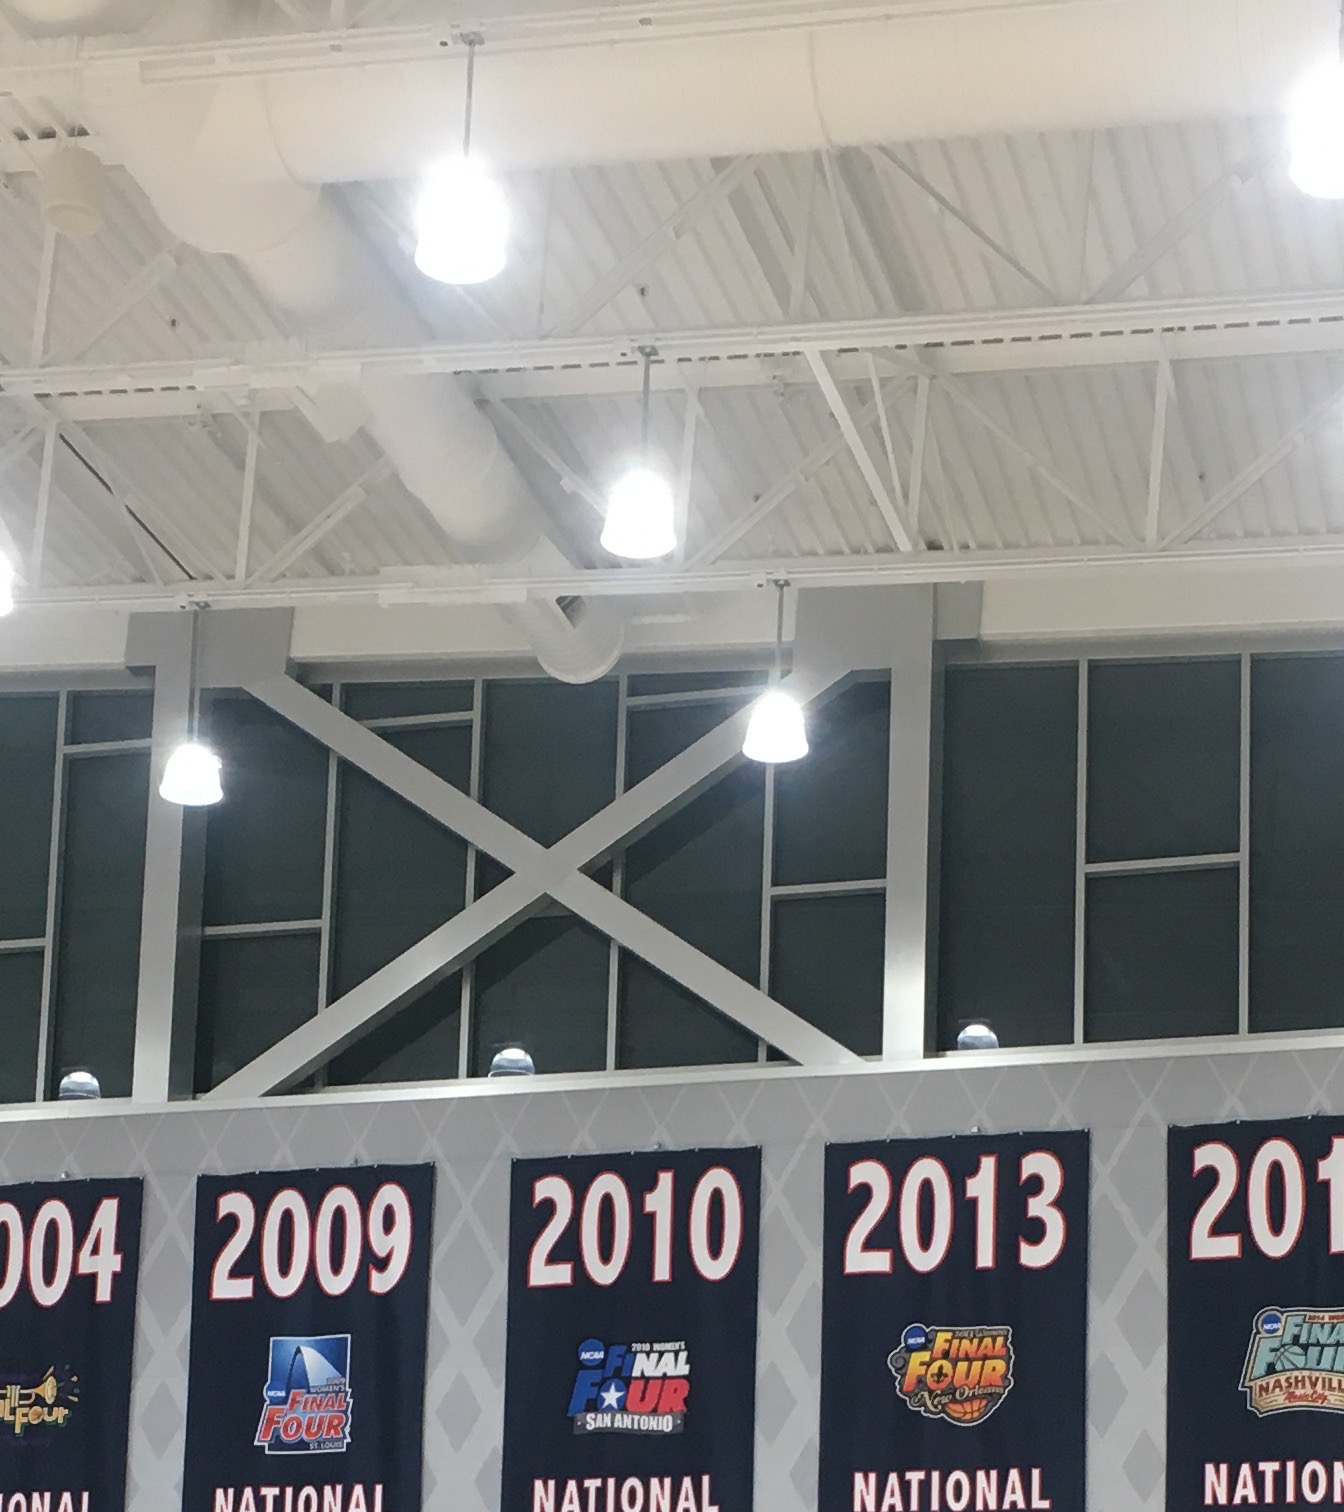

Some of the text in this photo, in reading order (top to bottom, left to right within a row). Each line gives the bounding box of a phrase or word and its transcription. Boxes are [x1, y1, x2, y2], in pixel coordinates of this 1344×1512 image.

[527, 1166, 743, 1288] 2010
[843, 1149, 1067, 1275] 2013
[209, 1182, 413, 1301] 2009
[579, 1350, 605, 1360] NCAA
[603, 1344, 691, 1377] FINAL
[931, 1331, 1008, 1358] FINAL
[902, 1350, 1007, 1393] FOUR
[288, 1389, 347, 1413] FINAL
[567, 1369, 690, 1417] FOUR
[259, 1405, 346, 1441] FOUR
[585, 1412, 674, 1433] SAN ANTONIO
